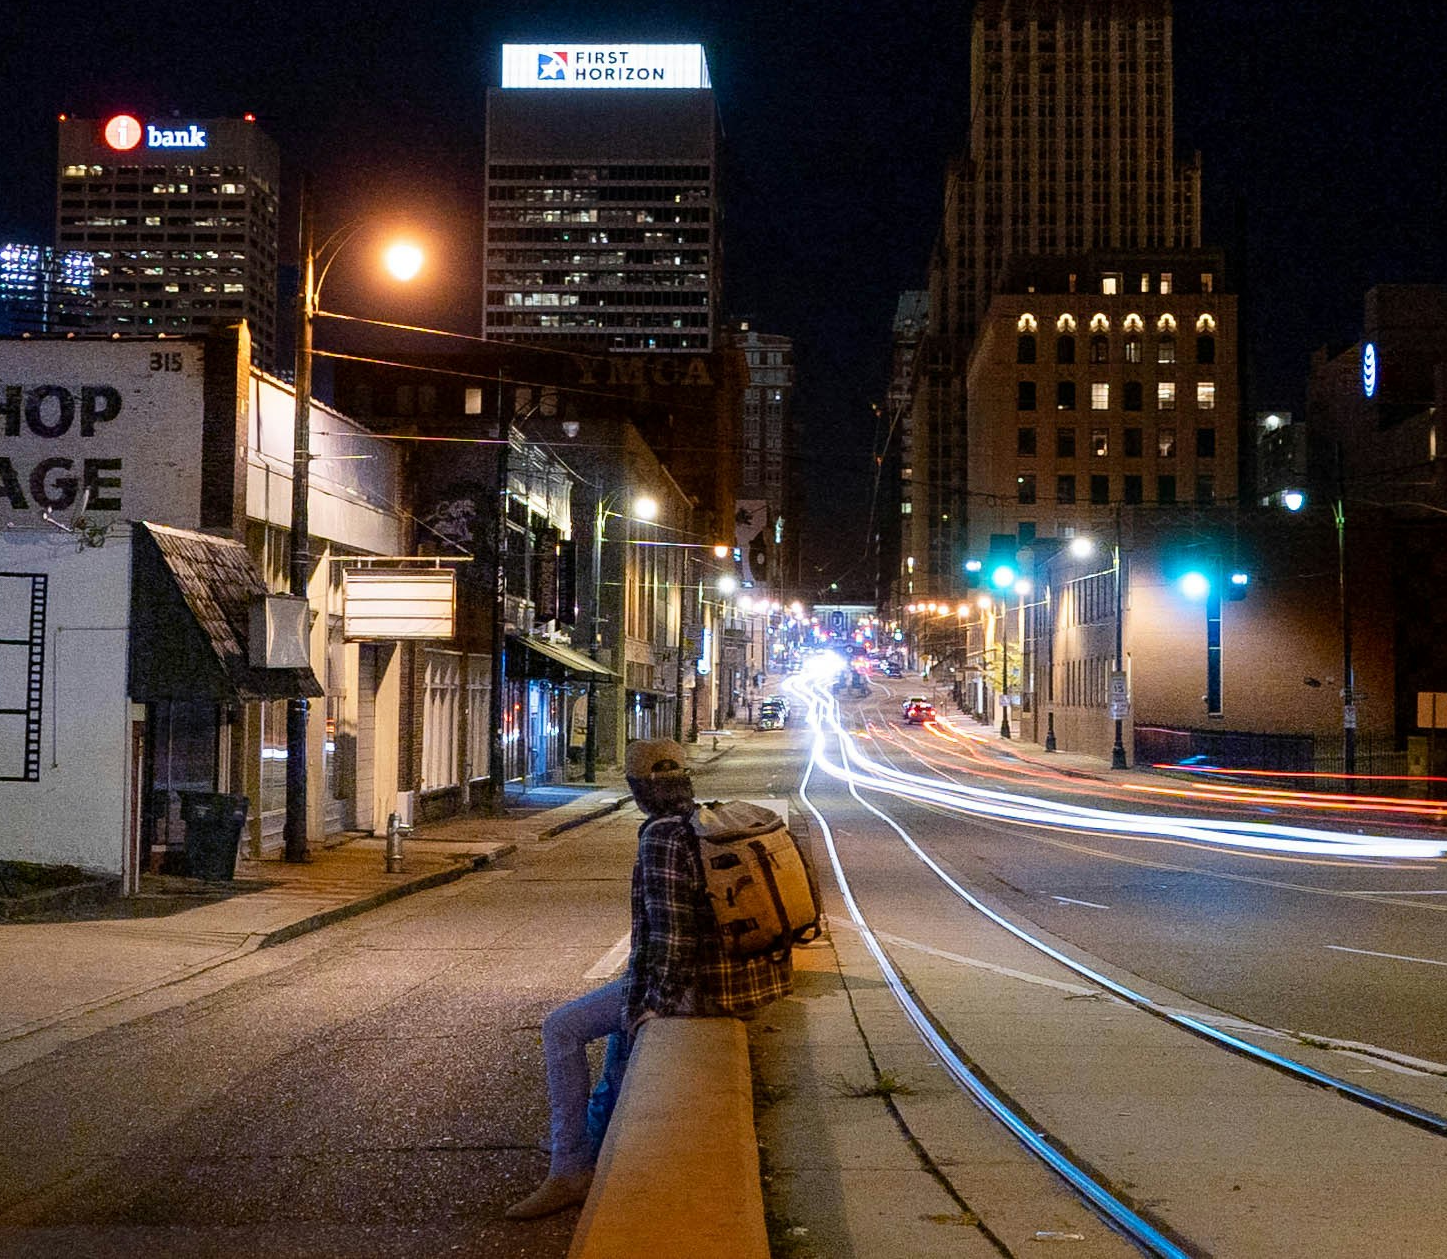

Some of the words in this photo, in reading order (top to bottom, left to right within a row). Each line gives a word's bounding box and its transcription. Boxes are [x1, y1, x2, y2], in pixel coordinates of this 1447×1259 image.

[575, 51, 630, 64] FIRST
[575, 67, 665, 80] HORIZON
[147, 125, 206, 147] bank
[149, 352, 183, 372] 315
[576, 356, 716, 386] YMCA
